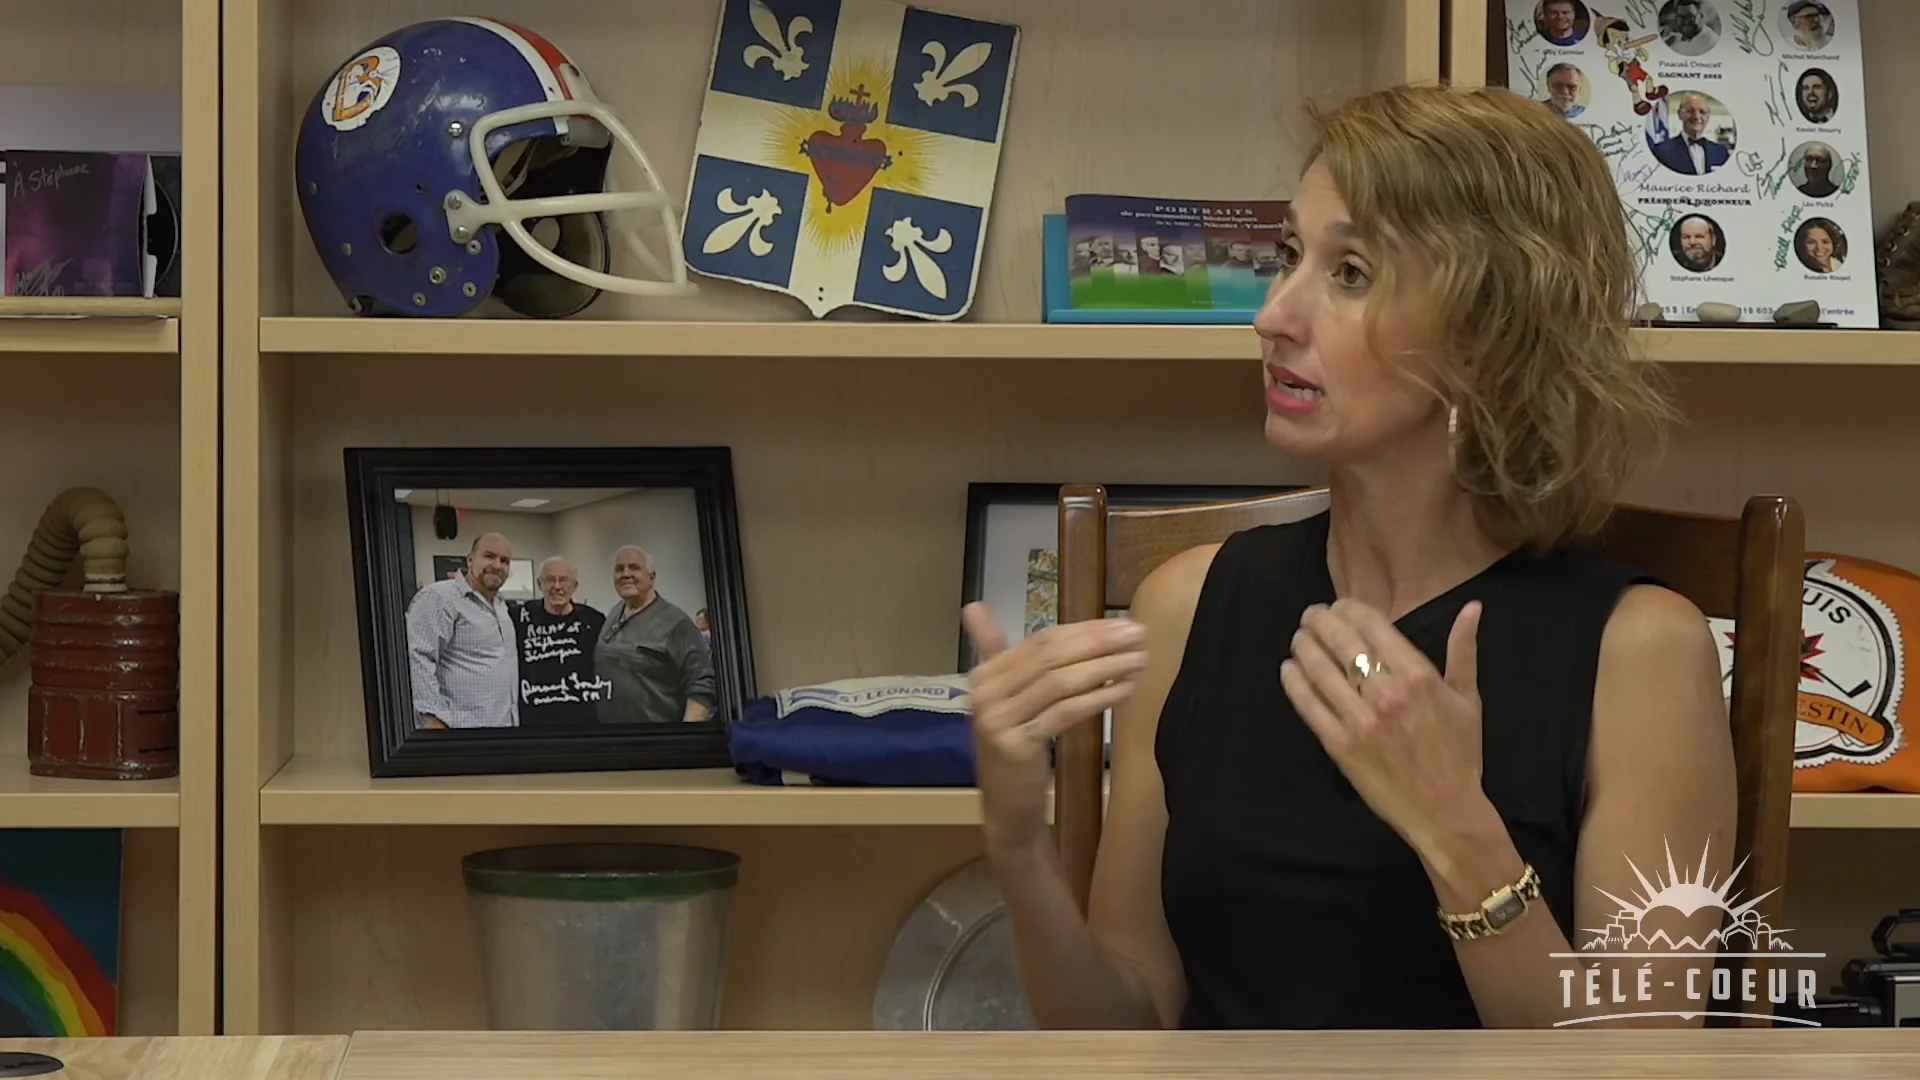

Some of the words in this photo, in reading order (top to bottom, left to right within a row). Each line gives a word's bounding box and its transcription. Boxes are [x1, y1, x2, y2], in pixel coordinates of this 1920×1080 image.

[1806, 53, 1840, 61] Marchand
[1658, 60, 1689, 69] Pascal
[1691, 60, 1722, 69] Doucet
[1658, 72, 1702, 80] GAGNANT
[28, 163, 90, 192] Stéphane
[1639, 183, 1694, 193] Maurice
[1697, 183, 1751, 193] Richard
[1155, 205, 1253, 215] PORTRAITS
[1703, 275, 1735, 283] Lévesque
[866, 687, 946, 701] LEONARD
